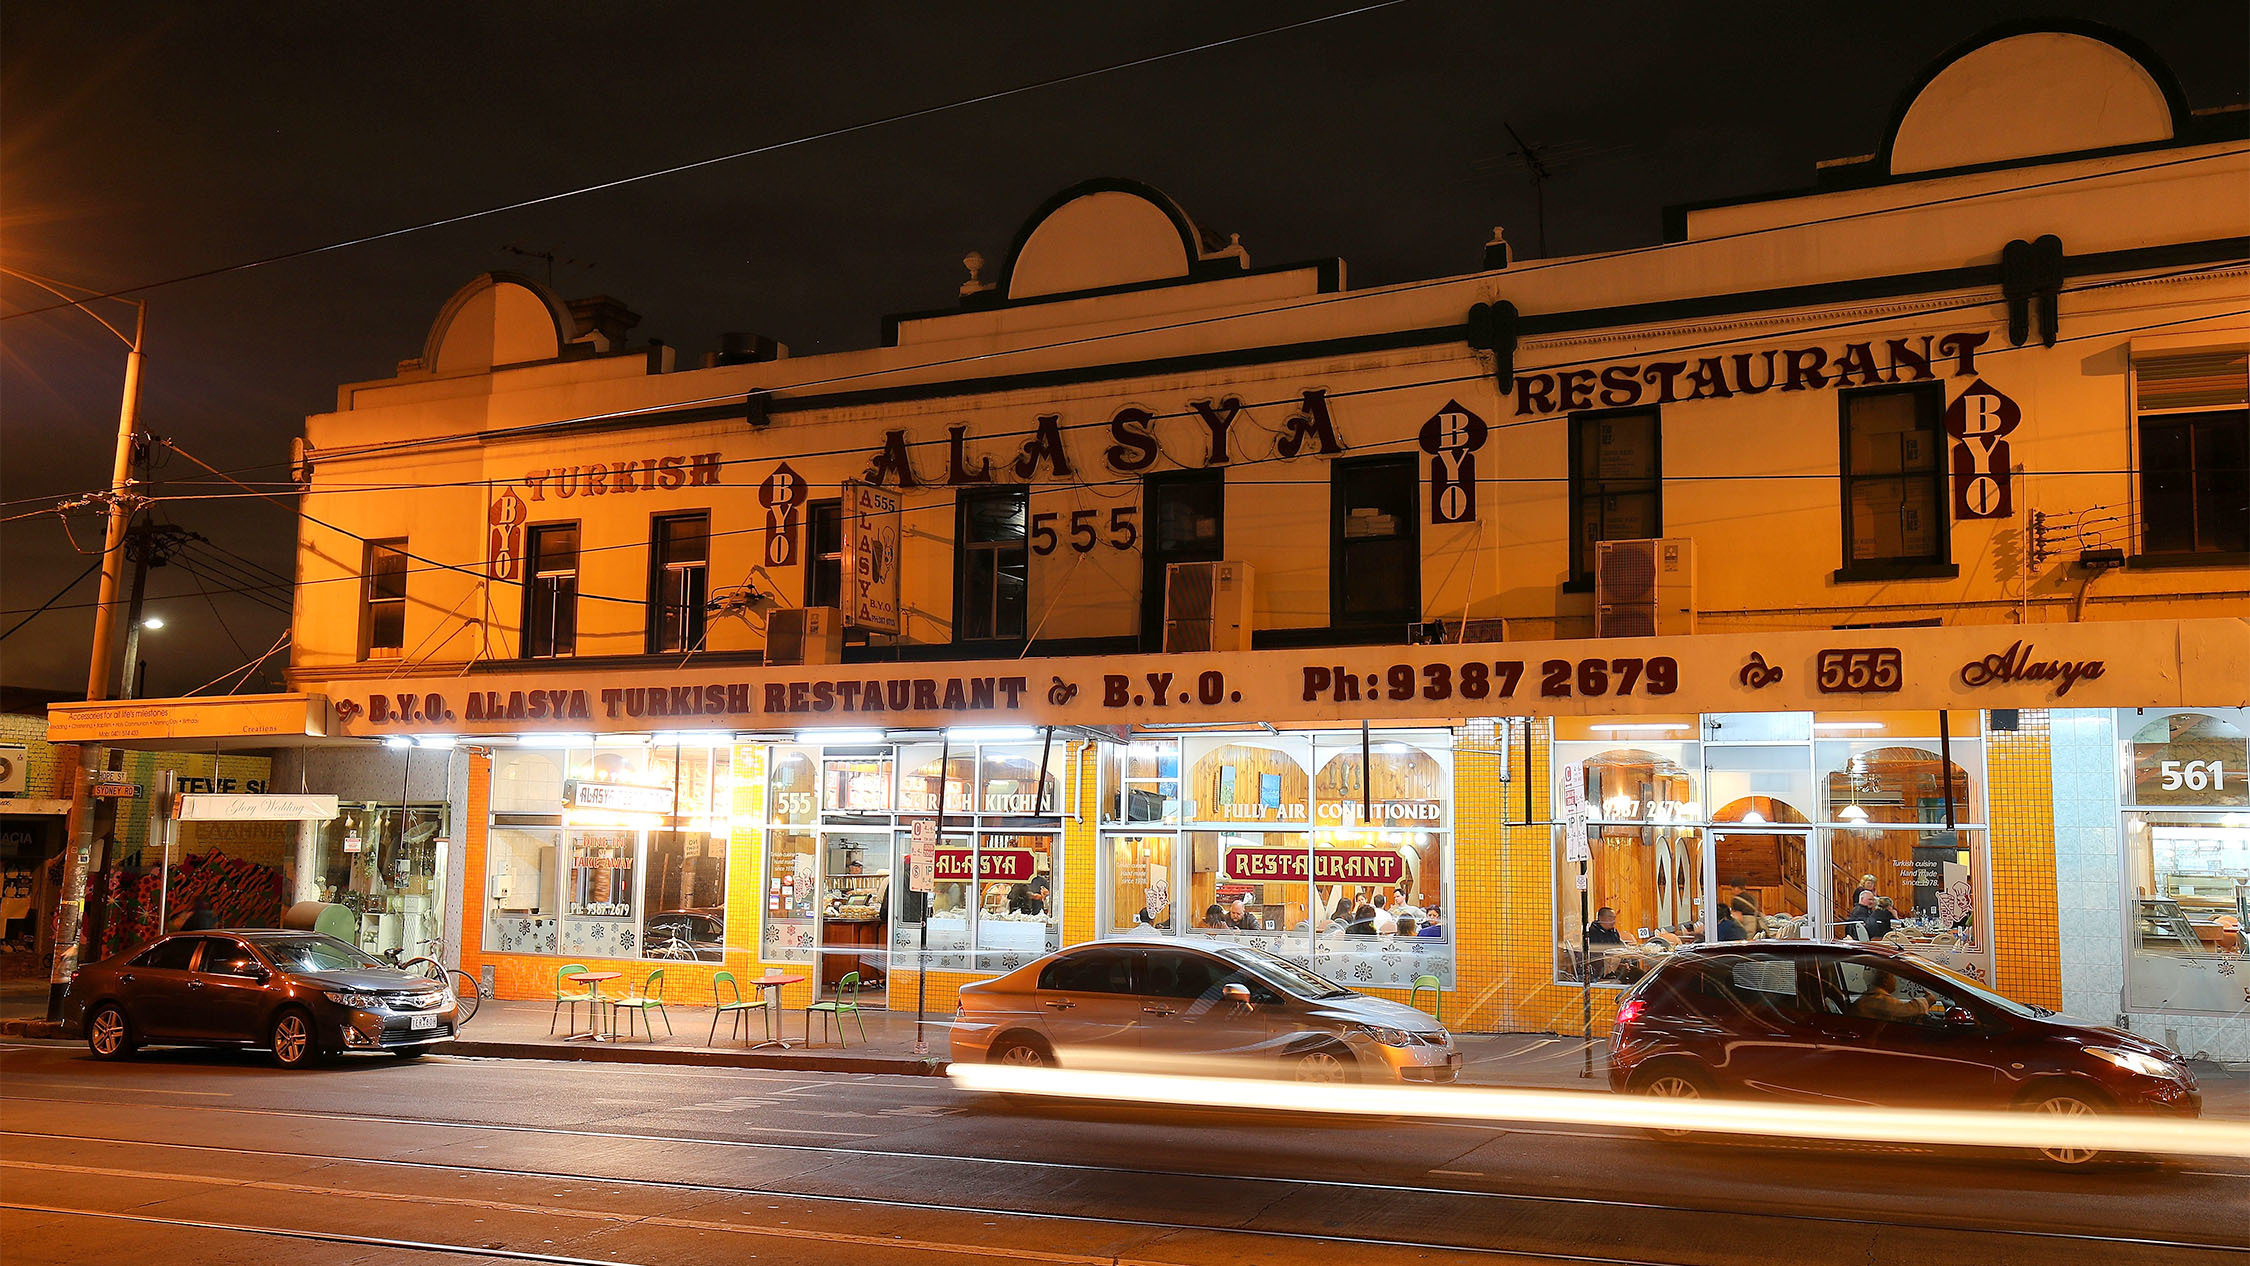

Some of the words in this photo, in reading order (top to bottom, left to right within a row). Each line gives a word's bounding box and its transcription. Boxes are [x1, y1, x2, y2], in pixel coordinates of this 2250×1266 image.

[1515, 331, 1990, 415] RESTAURANT
[864, 389, 1344, 486] ALASYA
[1963, 394, 2002, 516] BYO
[1438, 412, 1470, 519] BYO
[525, 452, 722, 501] TURKISH
[874, 494, 895, 512] 555
[769, 473, 794, 564] BYO
[496, 496, 516, 579] BYO
[1032, 505, 1139, 556] 555
[858, 489, 872, 622] ALASYA
[870, 599, 893, 613] B.Y.O.
[369, 693, 453, 723] B.Y.O.
[465, 689, 591, 721] ALASYA
[601, 684, 752, 717] TURKISH
[764, 677, 1027, 712] RESTAURANT
[1103, 670, 1242, 707] B.Y.O.
[1541, 655, 1678, 696] 2679
[1822, 652, 1899, 688] 555
[1961, 640, 2106, 697] Alasya
[68, 711, 103, 720] Accessories
[103, 711, 113, 719] for
[113, 710, 121, 718] all
[135, 708, 168, 717] milestones
[242, 725, 278, 733] Creations
[2160, 760, 2224, 791] 561
[96, 786, 122, 795] SYDNEY
[124, 787, 133, 795] RD
[226, 799, 257, 816] Glory
[261, 799, 304, 816] Wedding
[778, 792, 811, 814] 555
[985, 794, 1051, 812] KITCHEN
[1224, 803, 1268, 819] FULLY
[1276, 803, 1307, 819] AIR
[1317, 803, 1440, 820] CONDITIONED
[583, 836, 608, 848] DINE
[611, 836, 625, 848] IN
[936, 855, 1017, 875] ALASYA
[1235, 853, 1395, 879] RESTAURANT
[1892, 859, 1914, 868] Turkish
[1915, 860, 1938, 868] cuisine
[1900, 869, 1918, 878] Hand
[570, 902, 584, 915] Ph:
[610, 904, 630, 916] 2679
[1640, 928, 1648, 936] 20
